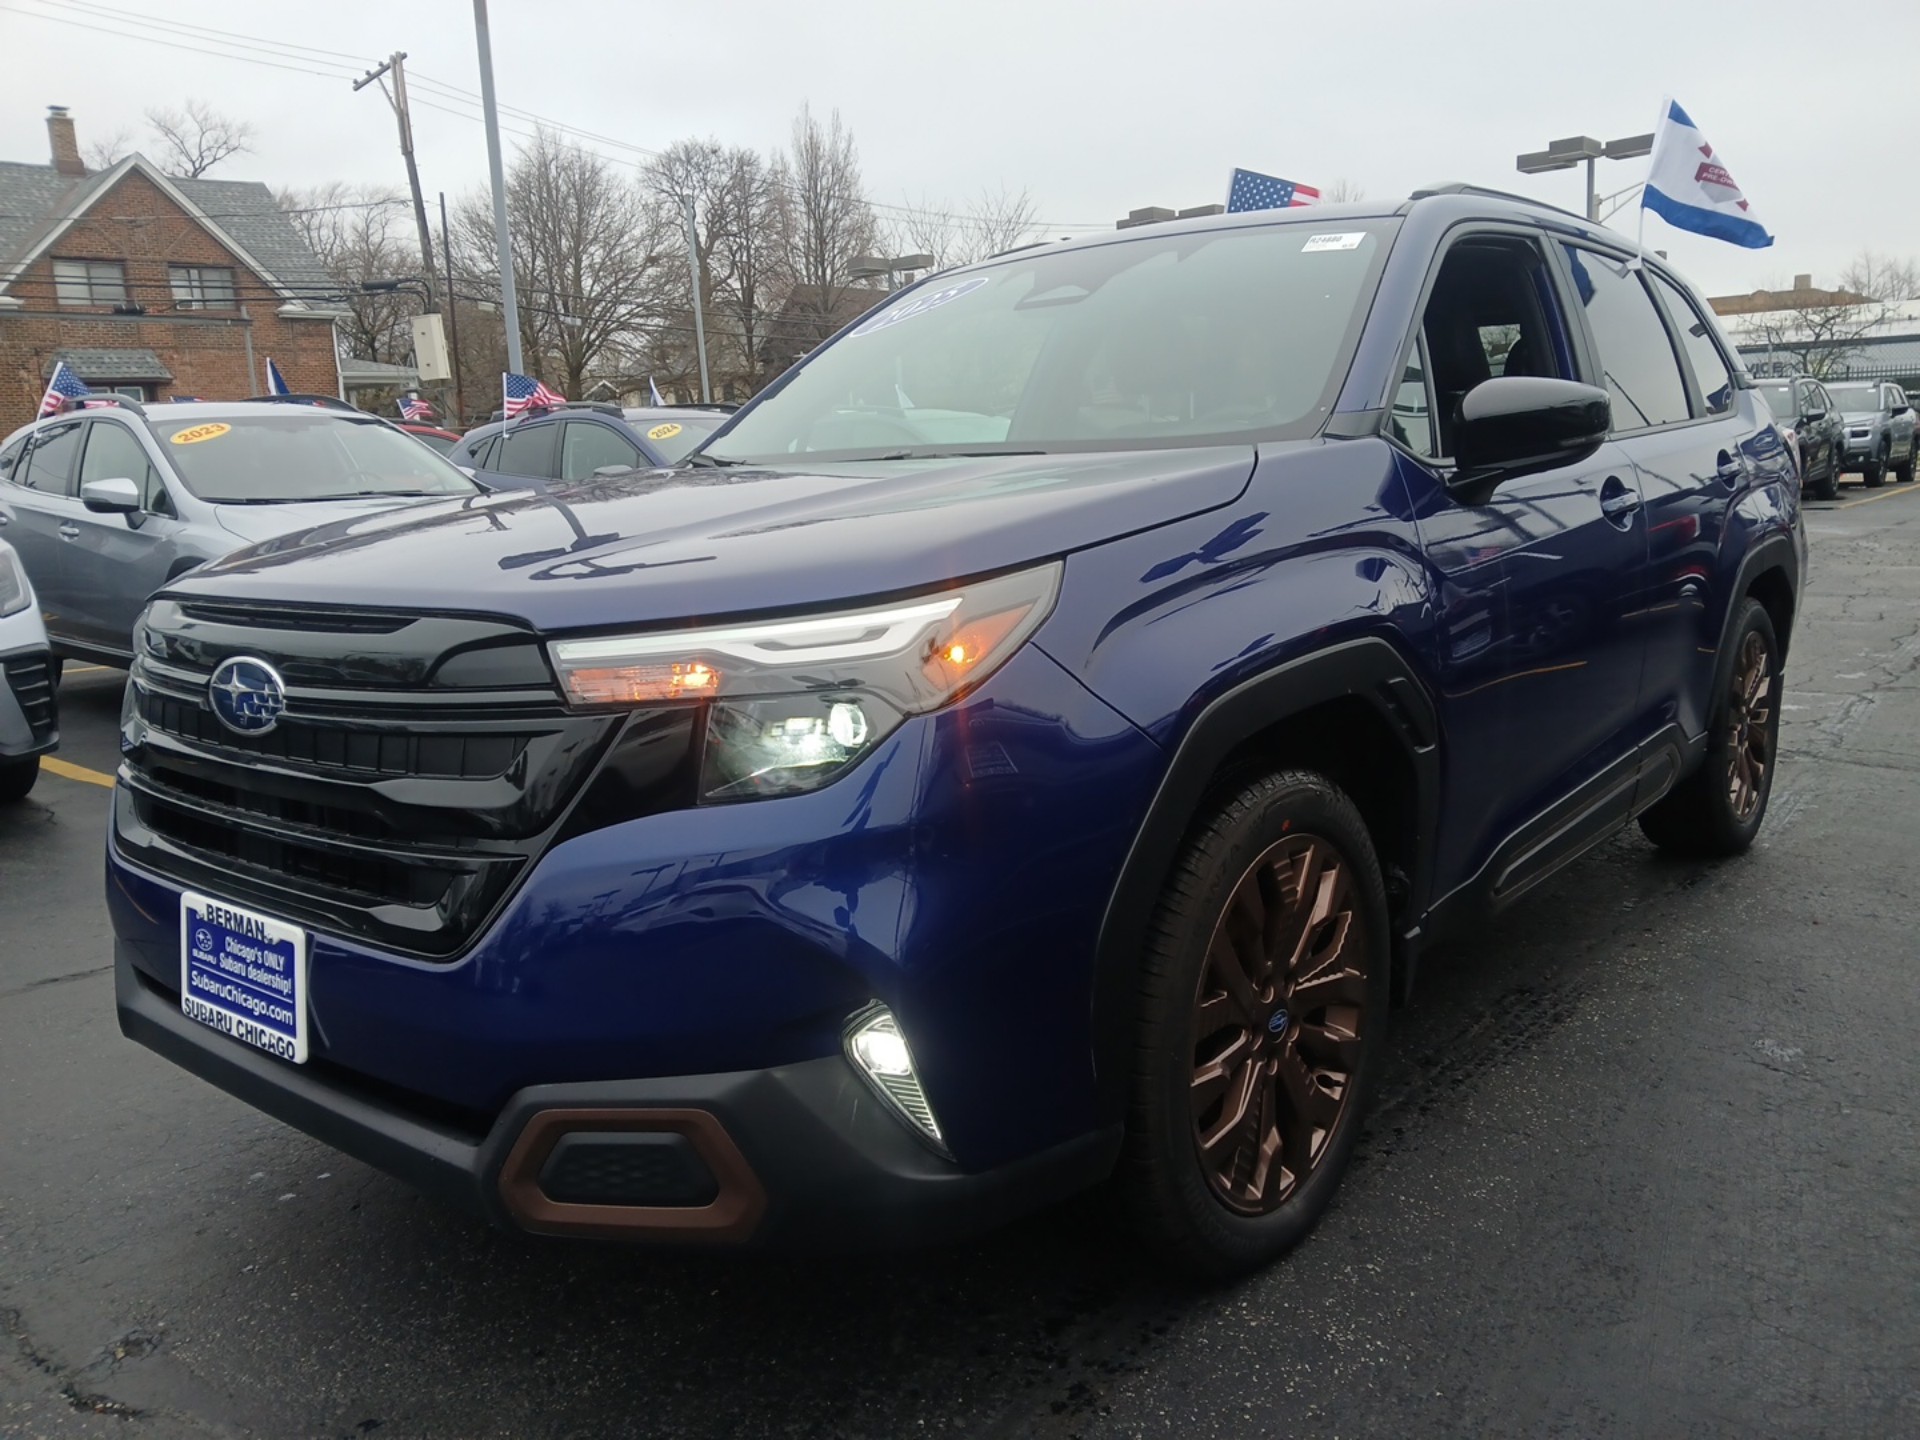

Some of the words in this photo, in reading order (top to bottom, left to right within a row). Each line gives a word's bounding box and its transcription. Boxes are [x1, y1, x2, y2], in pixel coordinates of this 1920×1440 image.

[177, 424, 226, 442] 2023
[651, 424, 680, 438] 2024
[206, 903, 265, 941] BERMAN
[192, 948, 217, 965] SUBARU
[225, 936, 262, 964] Chicago's
[263, 950, 285, 971] ONLY
[219, 952, 246, 977] Subaru
[247, 966, 293, 995] dealership!
[191, 970, 293, 1026] SubaruChicago.com
[185, 997, 233, 1034] SUBARU
[236, 1019, 296, 1061] CHICAGO
